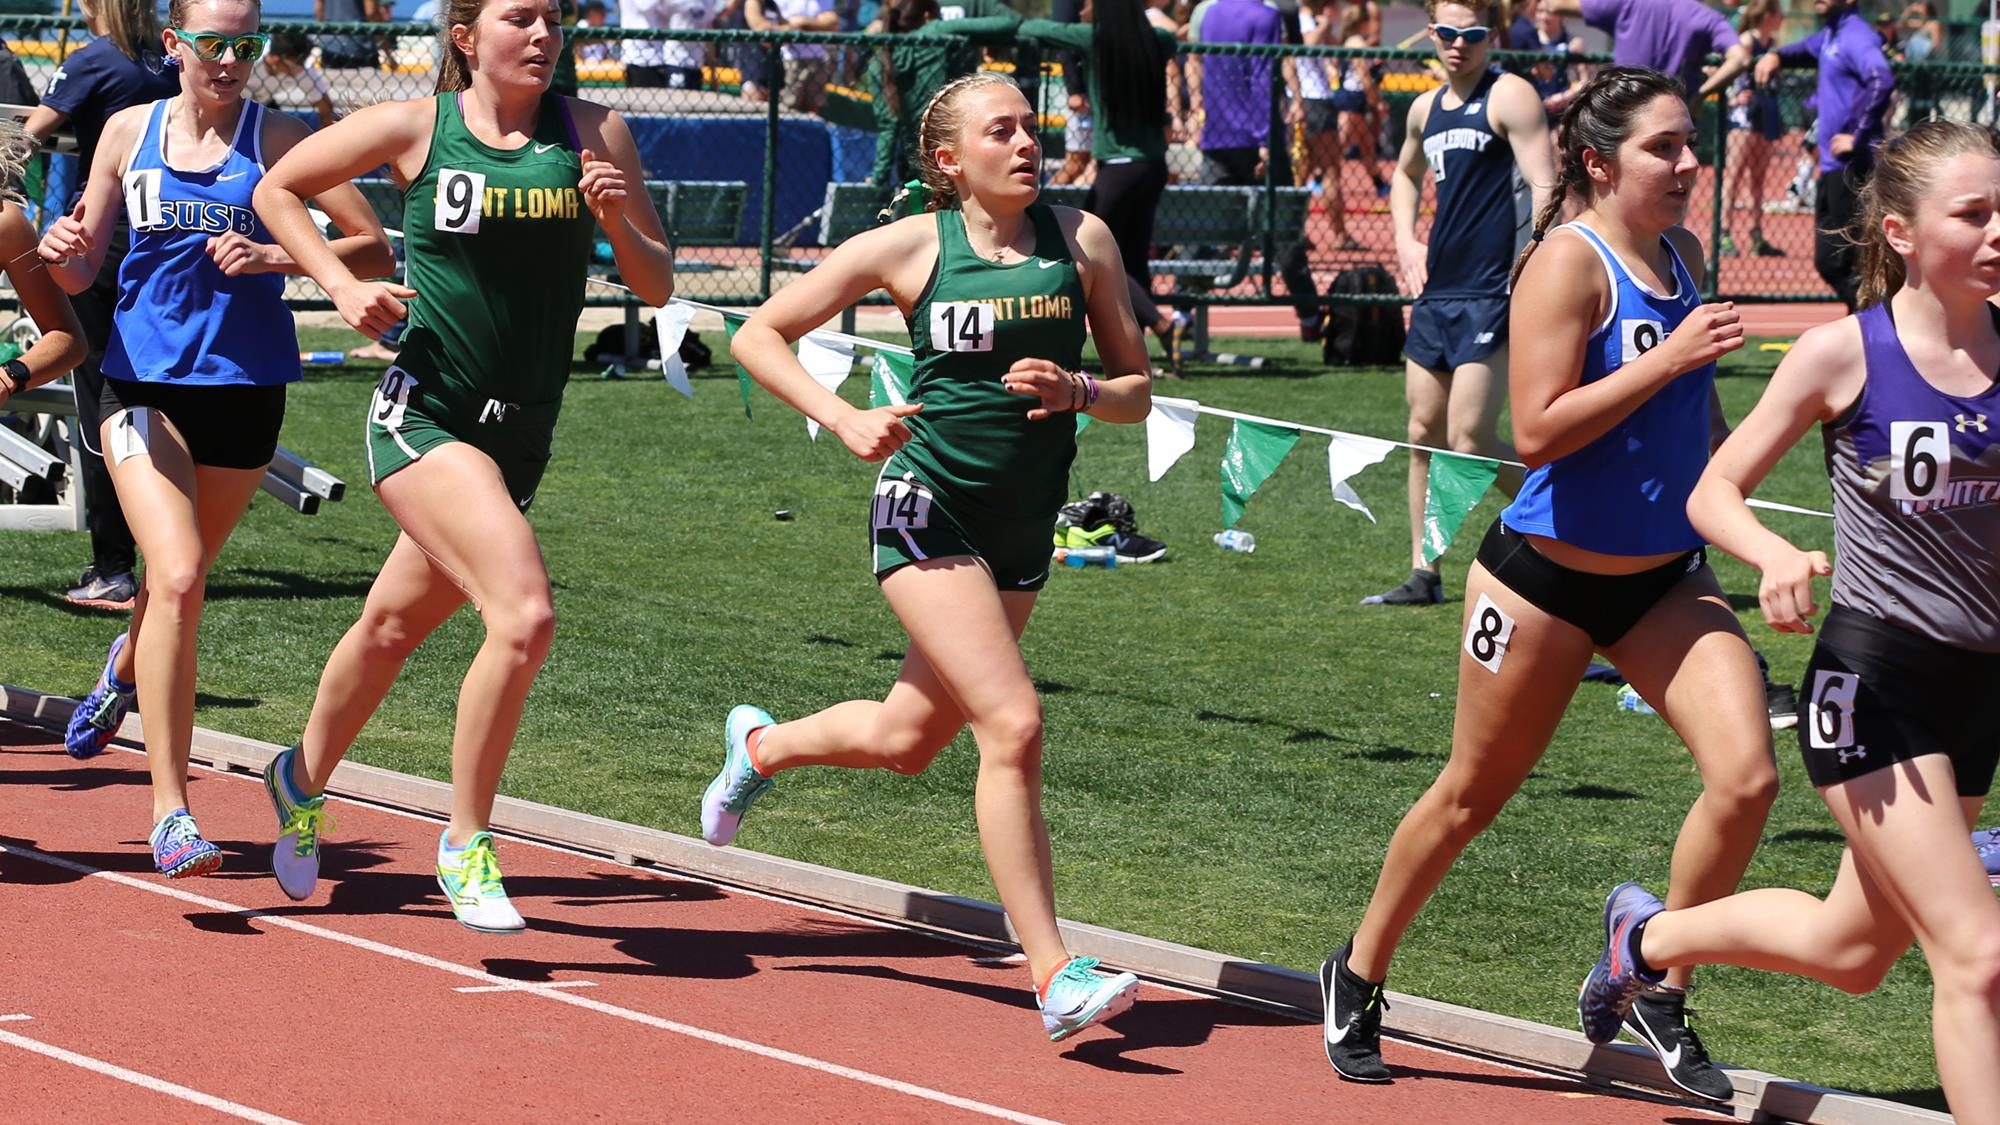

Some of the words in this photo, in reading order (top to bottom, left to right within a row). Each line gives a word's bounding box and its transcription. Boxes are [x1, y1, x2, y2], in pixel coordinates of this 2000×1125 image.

[133, 173, 148, 222] 1
[135, 200, 255, 237] SUSB
[445, 173, 474, 229] 9
[515, 187, 580, 219] LOMA
[941, 306, 984, 350] 14
[1019, 294, 1073, 320] LOMA
[378, 370, 406, 421] 9
[1904, 426, 1938, 498] 6
[886, 484, 919, 527] 14
[1472, 606, 1503, 662] 8
[1817, 675, 1845, 744] 6
